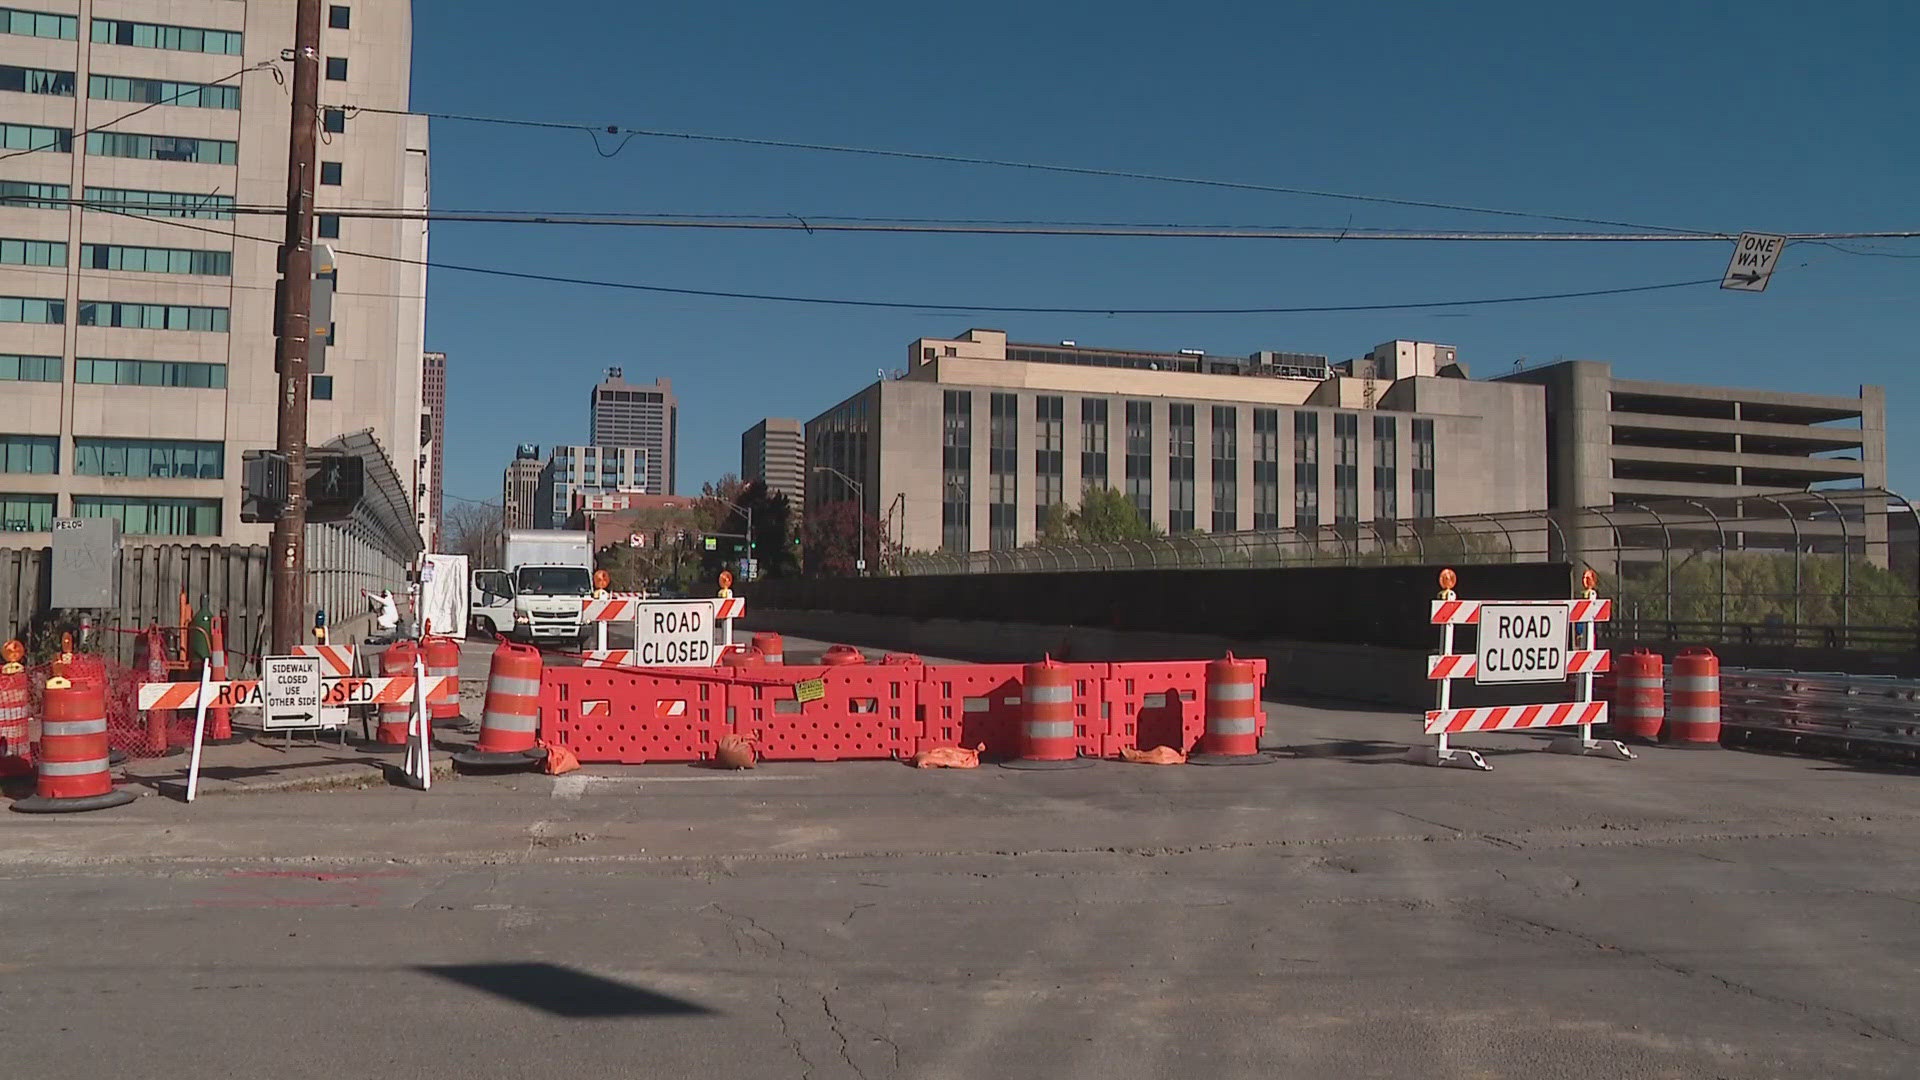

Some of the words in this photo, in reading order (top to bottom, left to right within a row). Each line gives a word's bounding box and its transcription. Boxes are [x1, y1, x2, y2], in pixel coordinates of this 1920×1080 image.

[1744, 237, 1776, 252] ONE
[1737, 252, 1771, 268] WAY
[653, 611, 701, 634] ROAD
[1499, 615, 1551, 639] ROAD
[642, 640, 709, 664] CLOSED
[1486, 647, 1560, 672] CLOSED
[272, 664, 313, 673] SIDEWALK
[278, 675, 308, 684] CLOSED
[219, 684, 263, 705] ROA
[285, 686, 300, 695] USE
[269, 697, 295, 707] OTHER
[297, 697, 316, 706] SIDE
